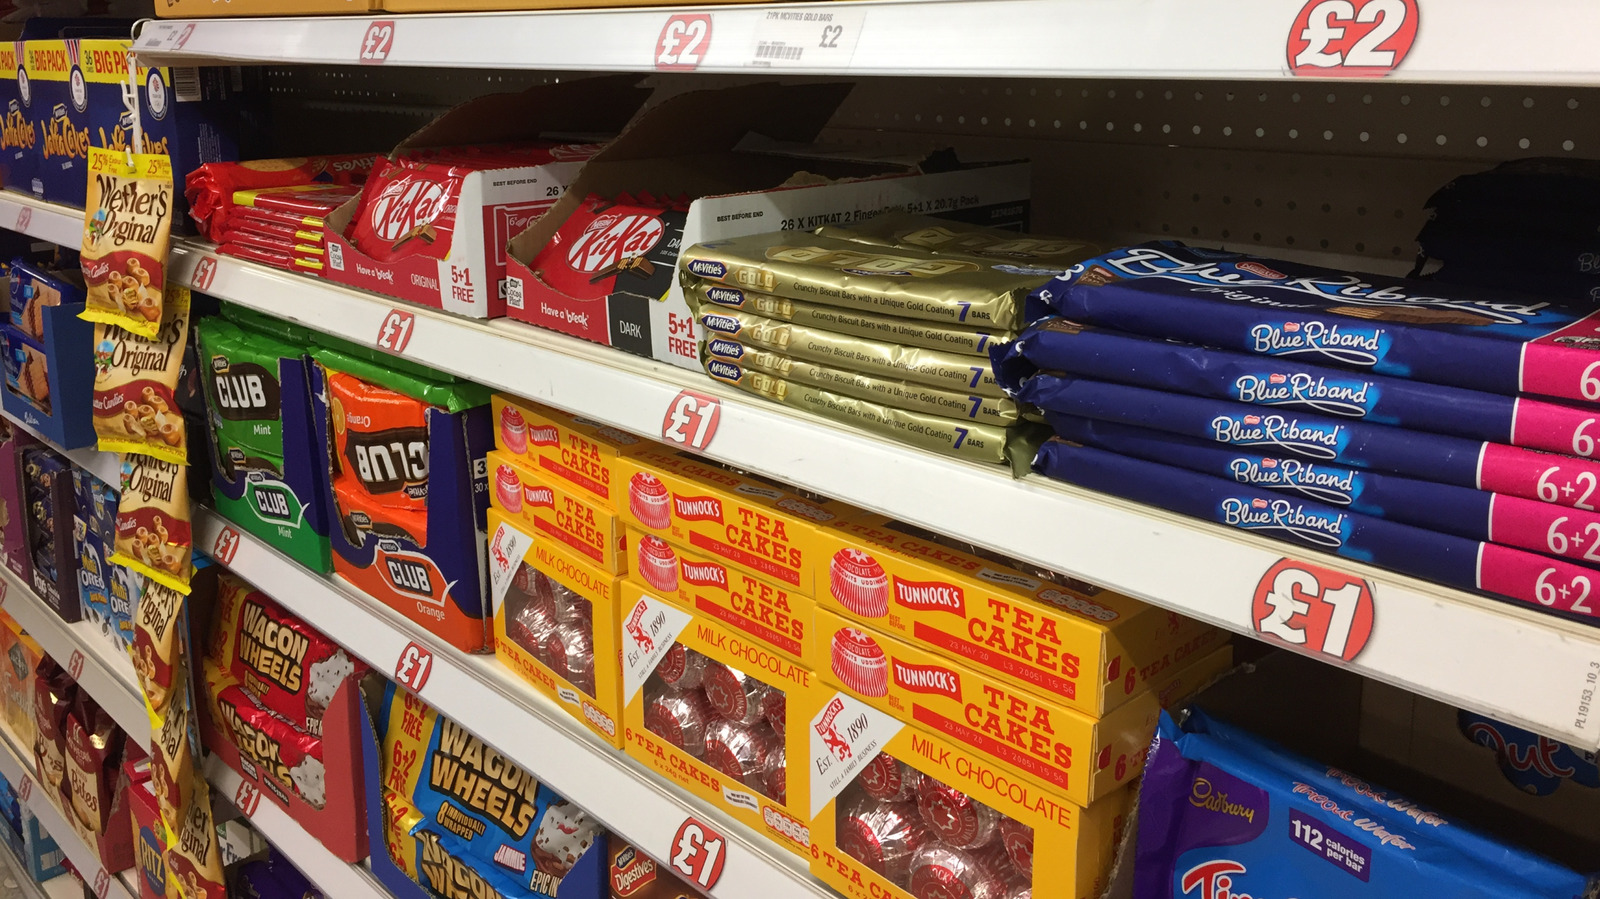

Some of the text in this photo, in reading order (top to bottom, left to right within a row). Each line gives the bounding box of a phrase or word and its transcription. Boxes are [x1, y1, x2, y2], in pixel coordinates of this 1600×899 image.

[803, 13, 818, 21] GOLD
[818, 13, 834, 21] BARS
[1295, 0, 1408, 68] £2
[361, 25, 392, 59] £2
[658, 19, 707, 65] £2
[819, 25, 843, 48] £2
[35, 50, 68, 72] BIG PACK
[94, 50, 115, 74] BIG
[546, 186, 559, 197] 26
[376, 180, 441, 240] KitKat
[732, 212, 752, 220] BEFORE
[781, 210, 851, 231] 26 X KITKAT 2
[569, 214, 663, 272] KitKat
[193, 257, 217, 290] £1
[356, 264, 371, 275] Have
[410, 273, 439, 291] ORIGINAL
[451, 265, 473, 287] 5+1
[738, 269, 774, 290] GOLD
[1107, 249, 1262, 286] Blue
[1285, 275, 1551, 319] Riband
[452, 286, 475, 303] FREE
[540, 302, 558, 318] Have
[756, 298, 792, 316] GOLD
[793, 281, 990, 322] Crunchy Biscuit Bars with Unique Gold Coating 7 BARS
[378, 313, 412, 352] £1
[619, 319, 642, 339] DARK
[668, 311, 695, 340] 5+1
[811, 310, 991, 352] Crunchy Biscuit Bars with Unique Gold Coating 7
[1251, 320, 1380, 357] Blue Riband
[112, 339, 173, 377] Original
[668, 335, 697, 360] FREE
[215, 373, 267, 409] CLUB
[1236, 372, 1368, 409] Blue Riband
[253, 424, 271, 435] Mint
[530, 427, 558, 443] TUNNOCK'S
[665, 395, 717, 449] £1
[1211, 414, 1339, 451] Blue Riband
[355, 441, 429, 482] CLUB
[568, 434, 601, 463] TEA
[128, 462, 178, 504] Original
[561, 448, 610, 486] CAKES
[1230, 457, 1354, 496] Blue Riband
[255, 490, 290, 516] CLUB
[524, 486, 553, 504] TUNNOCK'S
[1536, 466, 1598, 511] 6+2
[564, 496, 596, 527] TEA
[675, 497, 720, 518] TUNNOCK'S
[738, 507, 790, 543] TEA
[1221, 497, 1343, 538] Blue Riband
[215, 528, 239, 564] £1
[277, 525, 293, 539] Mint
[556, 510, 605, 550] CAKES
[725, 524, 802, 569] CAKES
[1547, 516, 1600, 562] 6+2
[81, 571, 105, 590] OREO
[387, 560, 431, 593] CLUB
[536, 546, 610, 600] MILK CHOCOLATE
[683, 562, 726, 584] TUNNOCK'S
[1535, 567, 1592, 614] 6+2
[416, 601, 445, 622] Orange
[742, 575, 792, 613] TEA
[897, 581, 960, 609] TUNNOCK'S
[649, 610, 666, 637] 1890
[730, 591, 804, 640] CAKES
[988, 598, 1062, 646] TEA
[1260, 567, 1363, 658] £1
[243, 601, 310, 664] WAGON
[968, 617, 1080, 679] CAKES
[239, 632, 302, 693] WHEELS
[397, 645, 431, 690] £1
[697, 624, 810, 688] MILK CHOCOLATE
[961, 643, 976, 656] MAY
[979, 651, 988, 661] 20
[896, 663, 957, 693] TUNNOCK'S
[400, 711, 424, 742] FREE
[846, 712, 869, 744] 1890
[983, 685, 1055, 735] TEA
[964, 702, 1072, 770] CAKES
[391, 739, 417, 778] 6+2
[625, 727, 720, 793] 6 TEA CAKES
[71, 768, 97, 813] Bites
[236, 780, 260, 816] £1
[431, 751, 539, 838] WHEELS
[911, 733, 1072, 830] MILK CHOCOLATE
[1188, 777, 1255, 824] Cadbury
[444, 819, 474, 840] WRAPPED
[446, 803, 486, 836] INDIVIDUALLY
[1291, 819, 1323, 851] 112
[1353, 817, 1417, 851] Wafer
[140, 835, 164, 884] RITZ
[493, 844, 527, 873] JAMMIE
[672, 823, 723, 887] £1
[810, 843, 865, 889] 6 TEA
[1325, 837, 1365, 867] calories
[1326, 848, 1363, 873] per bar
[530, 869, 550, 895] EPIC
[614, 859, 654, 892] Digestives
